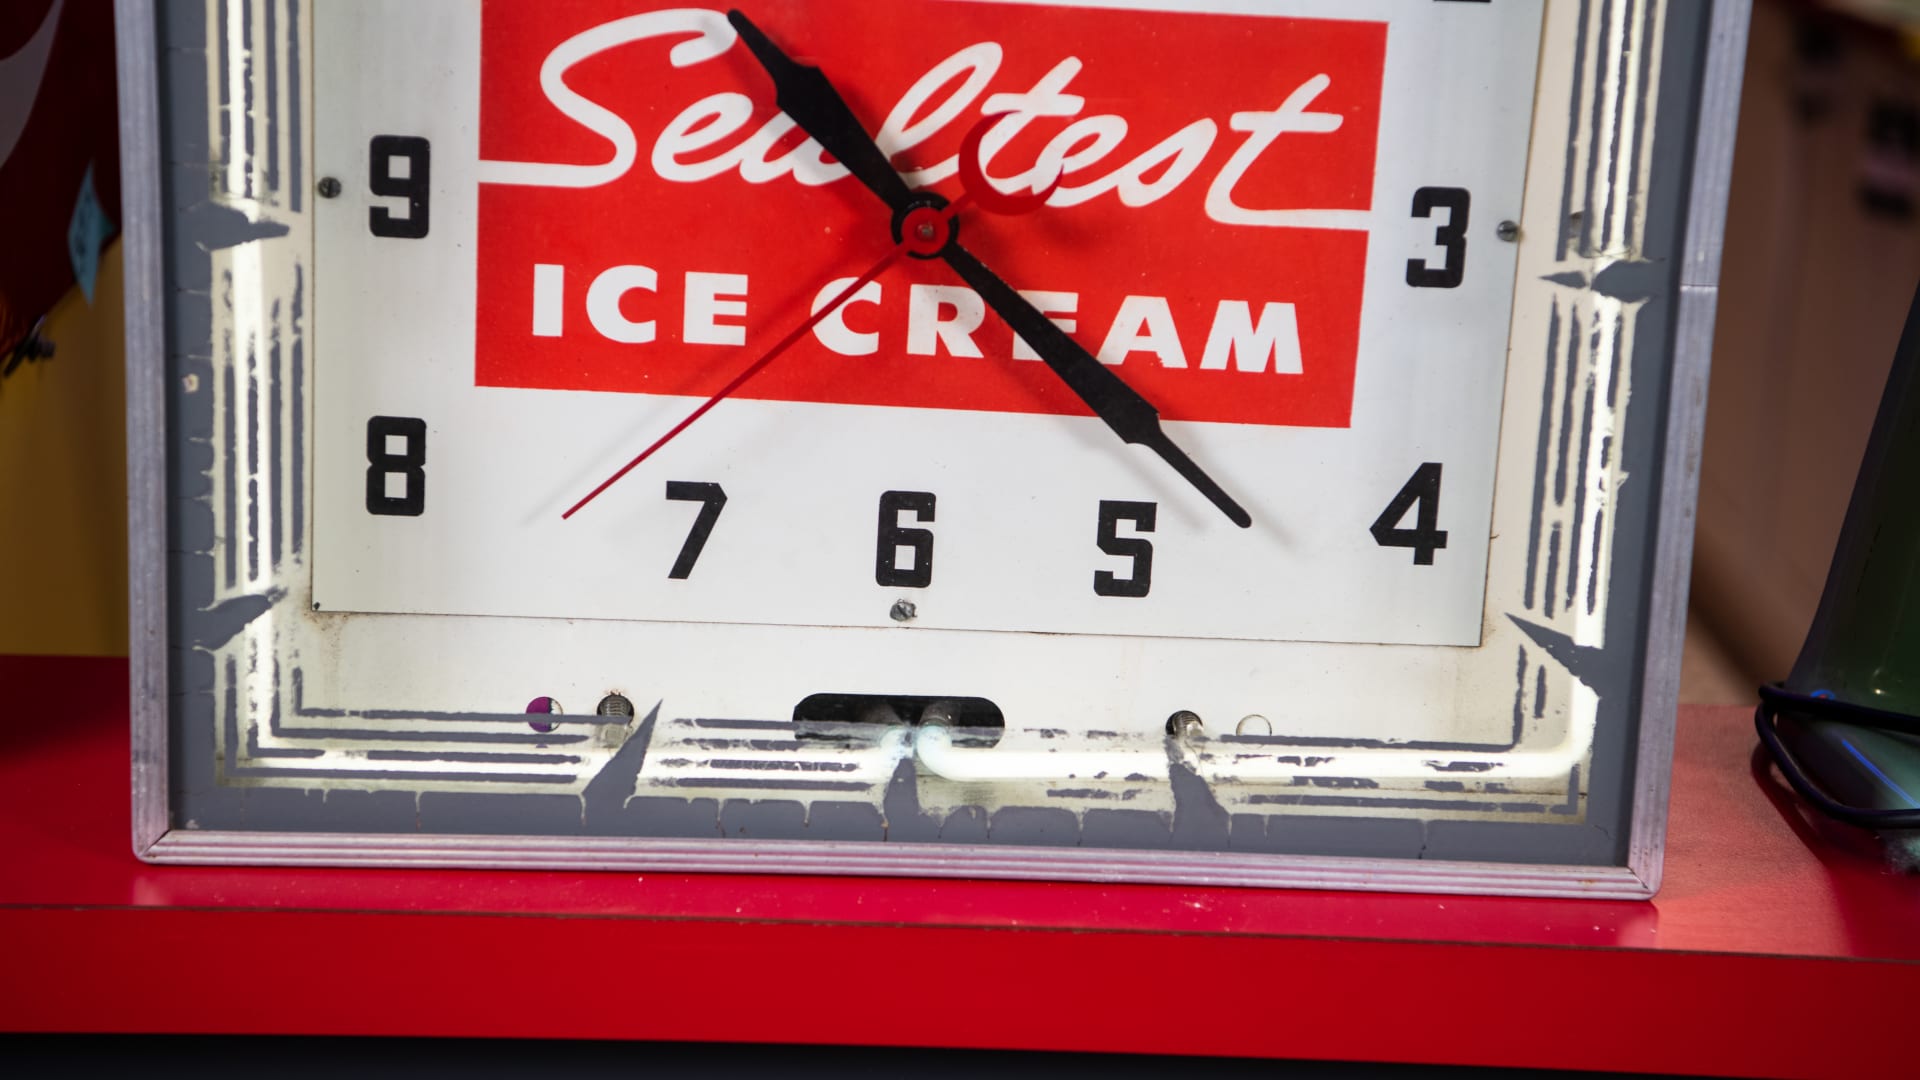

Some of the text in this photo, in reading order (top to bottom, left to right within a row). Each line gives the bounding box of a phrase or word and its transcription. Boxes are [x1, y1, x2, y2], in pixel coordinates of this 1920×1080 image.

[479, 8, 1371, 230] Sealtest
[370, 135, 430, 239] 9
[1406, 187, 1470, 288] 3
[532, 263, 749, 346] ICE
[366, 416, 426, 517] 8
[1370, 463, 1448, 565] 4
[666, 481, 727, 579] 7
[876, 491, 936, 588] 6
[1094, 500, 1157, 597] 5
